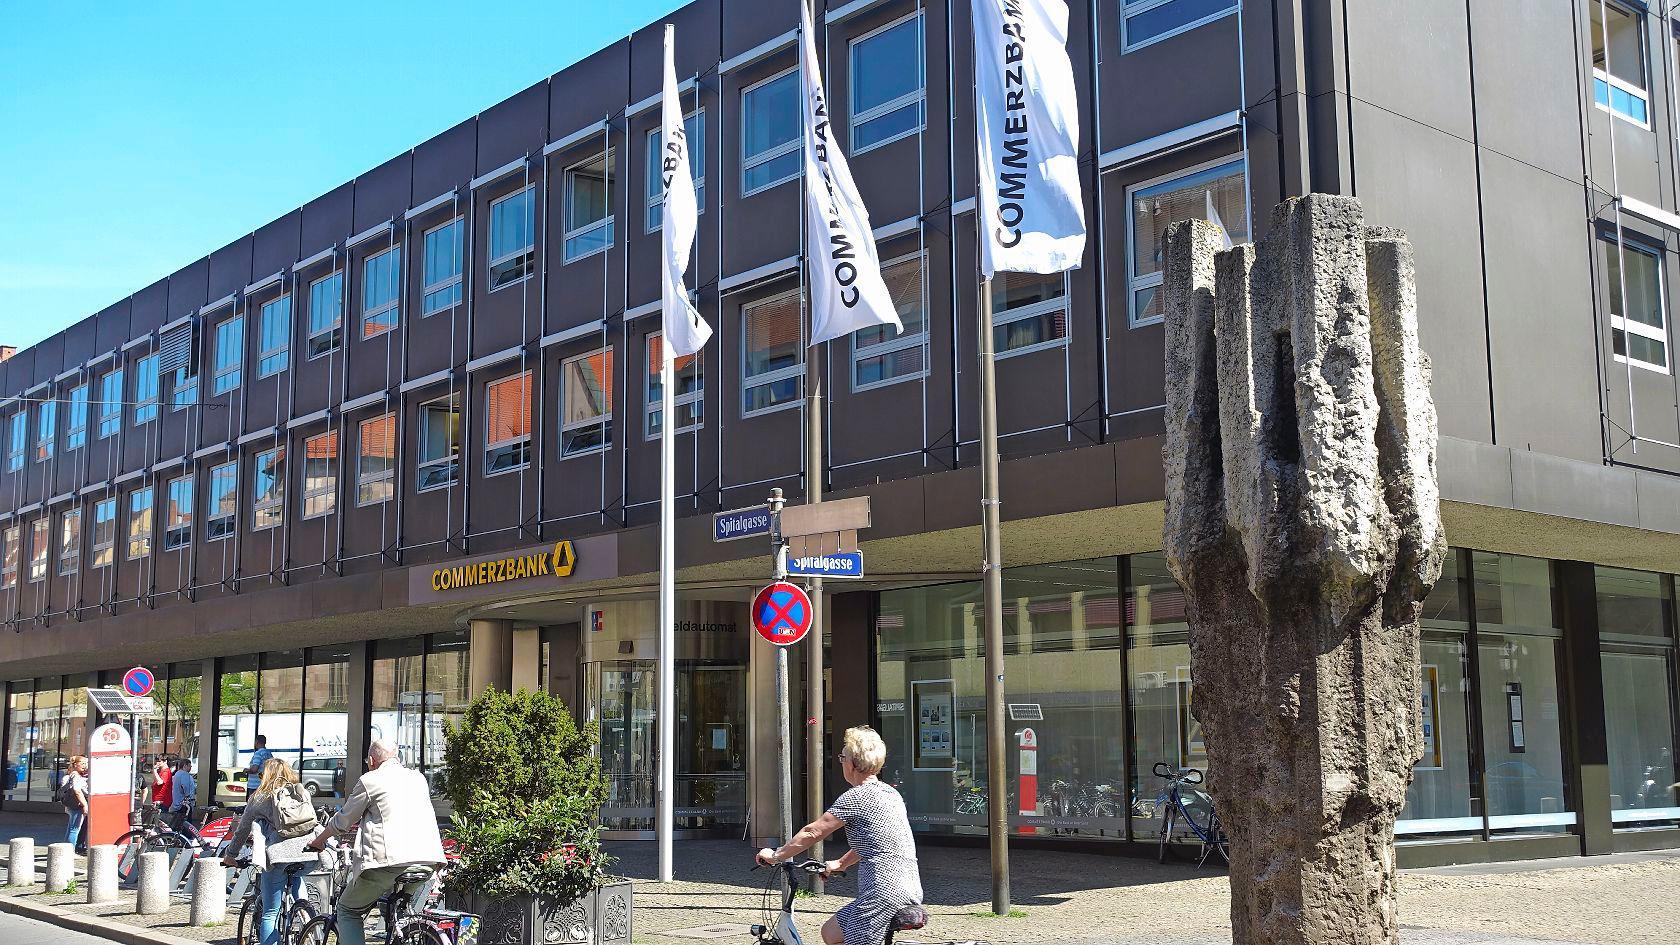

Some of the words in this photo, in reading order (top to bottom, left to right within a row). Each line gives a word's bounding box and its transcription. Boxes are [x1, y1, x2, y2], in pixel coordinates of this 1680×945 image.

[720, 514, 768, 537] Spitalgasse
[432, 552, 548, 591] COMMERZBANK
[674, 620, 737, 632] eldautomat
